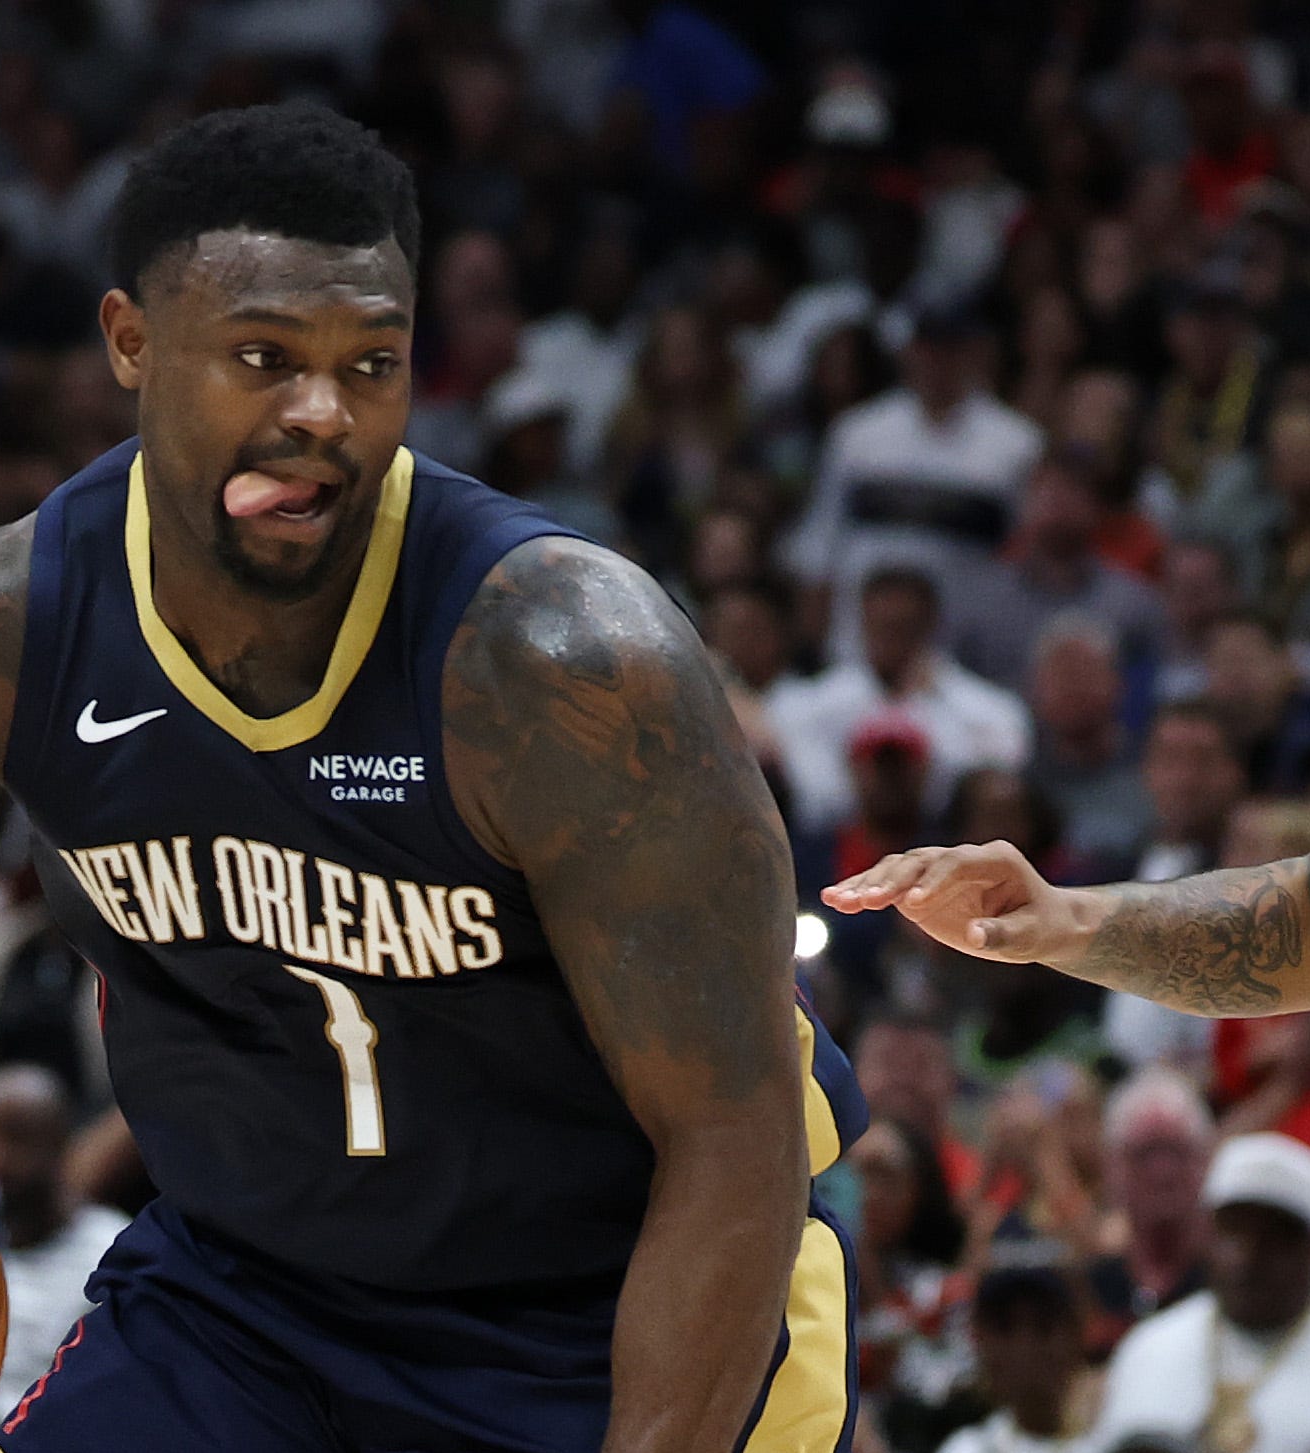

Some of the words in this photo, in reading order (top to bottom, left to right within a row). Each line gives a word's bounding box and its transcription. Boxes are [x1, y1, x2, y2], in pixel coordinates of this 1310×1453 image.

[309, 754, 426, 781] NEWAGE
[330, 785, 406, 802] GARAGE
[57, 835, 207, 943] NEW
[212, 835, 504, 978] ORLEANS
[282, 964, 386, 1156] 1
